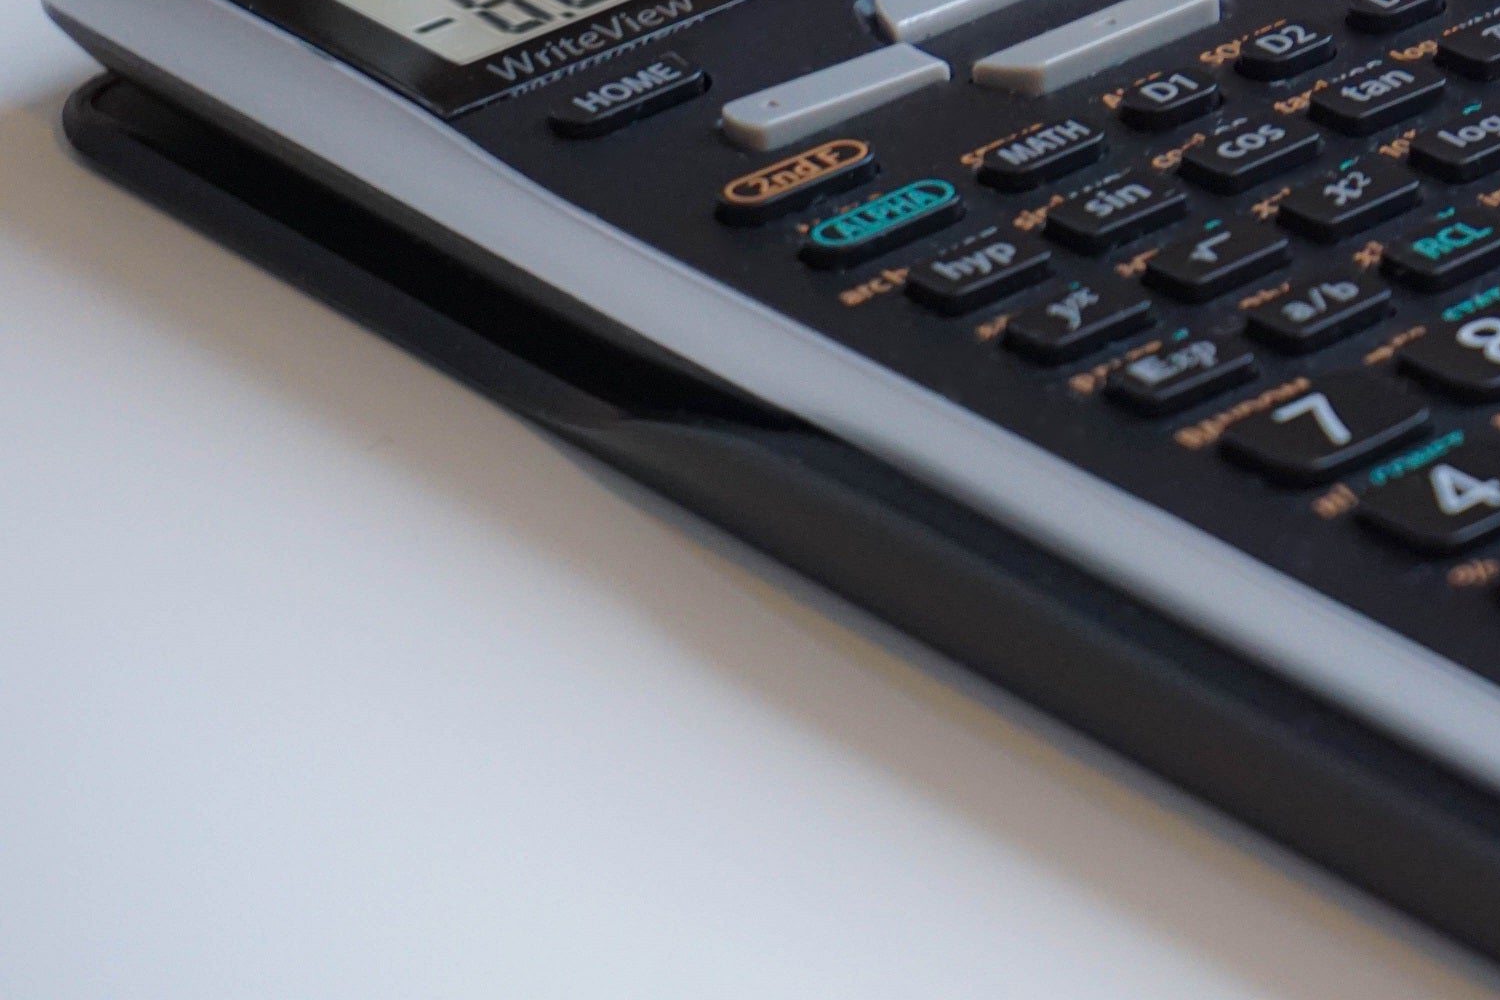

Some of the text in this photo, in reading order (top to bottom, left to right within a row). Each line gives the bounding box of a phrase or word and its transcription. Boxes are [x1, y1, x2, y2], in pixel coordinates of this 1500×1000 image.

[1256, 24, 1315, 55] D2
[574, 62, 680, 112] HOME
[1145, 73, 1199, 103] D1
[1340, 69, 1415, 102] tan
[1000, 119, 1091, 165] MATH
[1217, 123, 1286, 158] cos
[838, 187, 941, 240] ALPHA
[1084, 183, 1153, 217] sin
[1411, 221, 1493, 260] RCL
[931, 242, 1017, 280] hyp
[1274, 392, 1351, 445] 7
